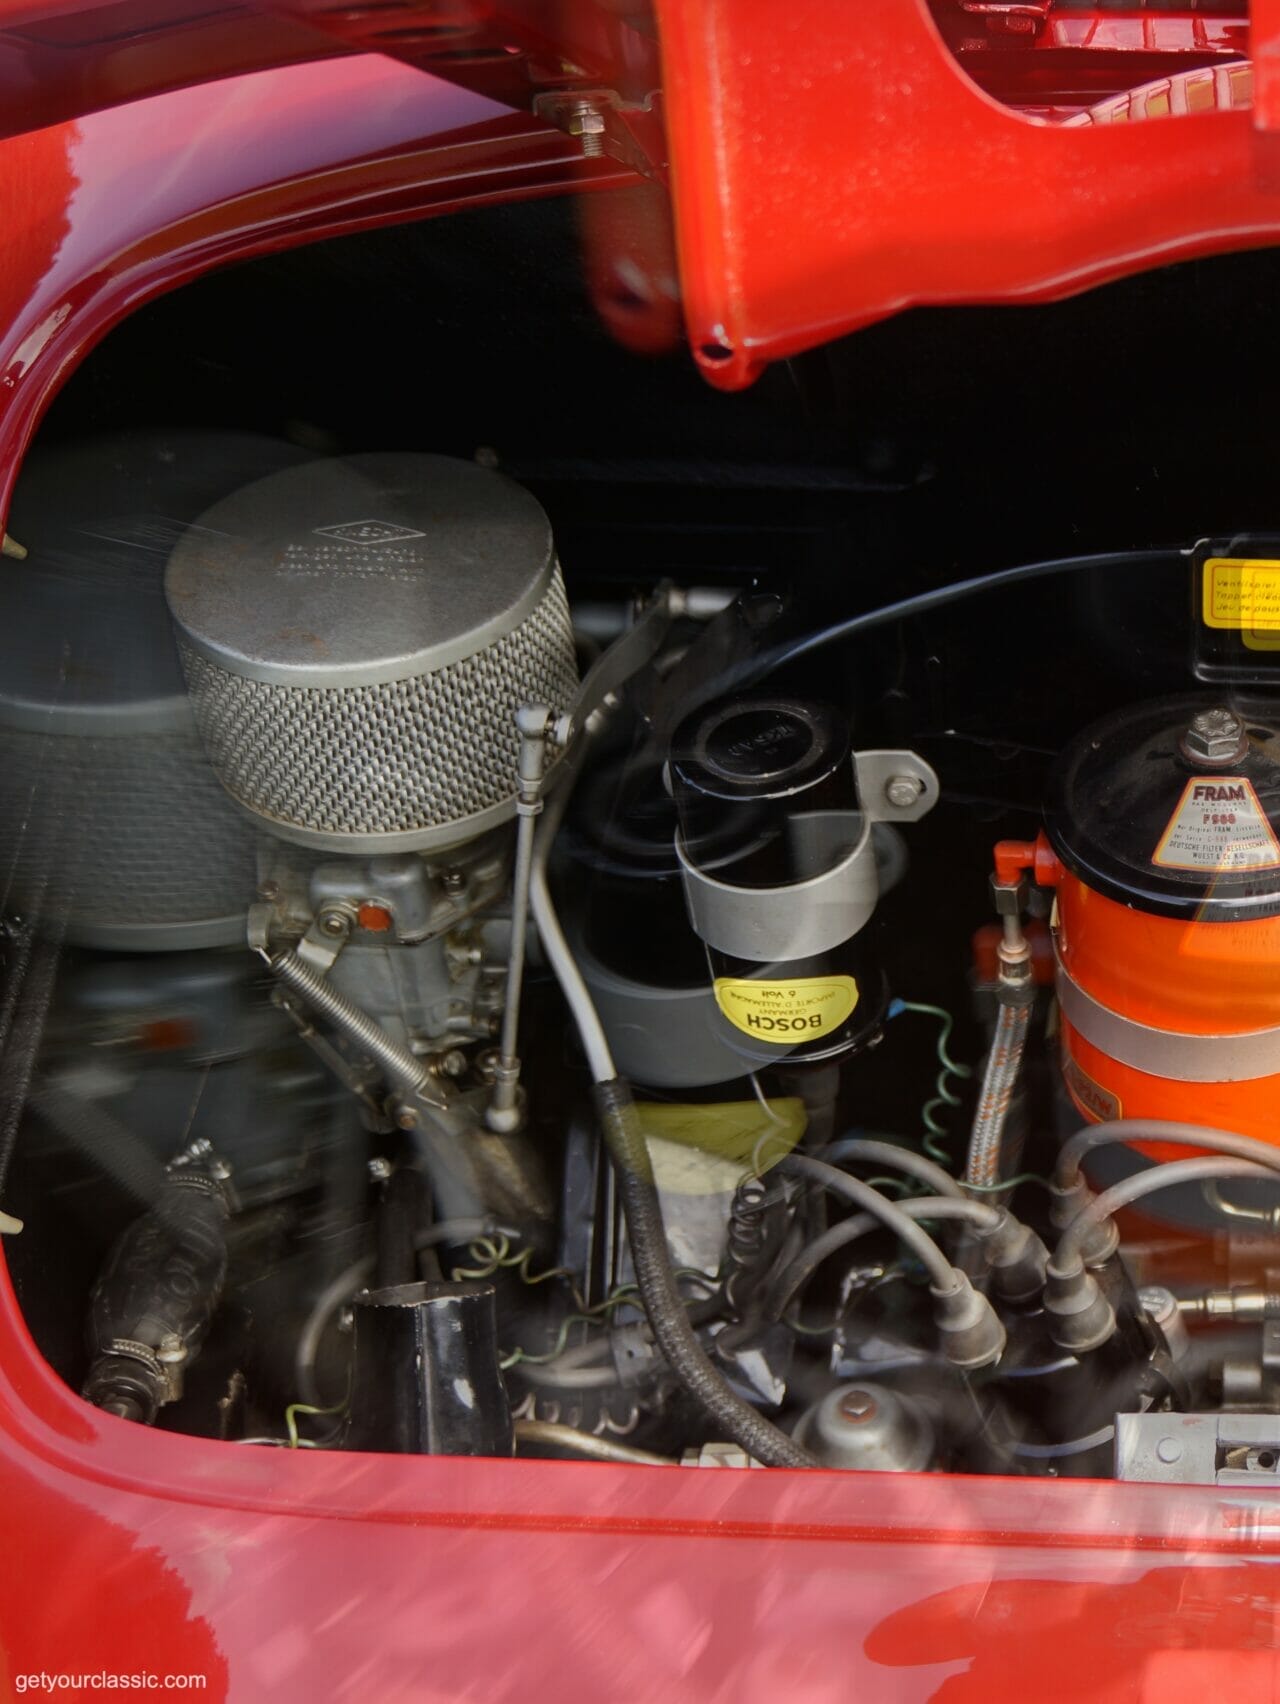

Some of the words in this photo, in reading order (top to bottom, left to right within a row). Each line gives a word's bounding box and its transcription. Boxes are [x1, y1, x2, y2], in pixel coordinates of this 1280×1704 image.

[1193, 785, 1246, 801] FRAM
[761, 990, 784, 999] Volt
[788, 990, 797, 998] 6
[758, 1008, 807, 1016] GERMANY
[746, 1013, 823, 1032] BOSCH
